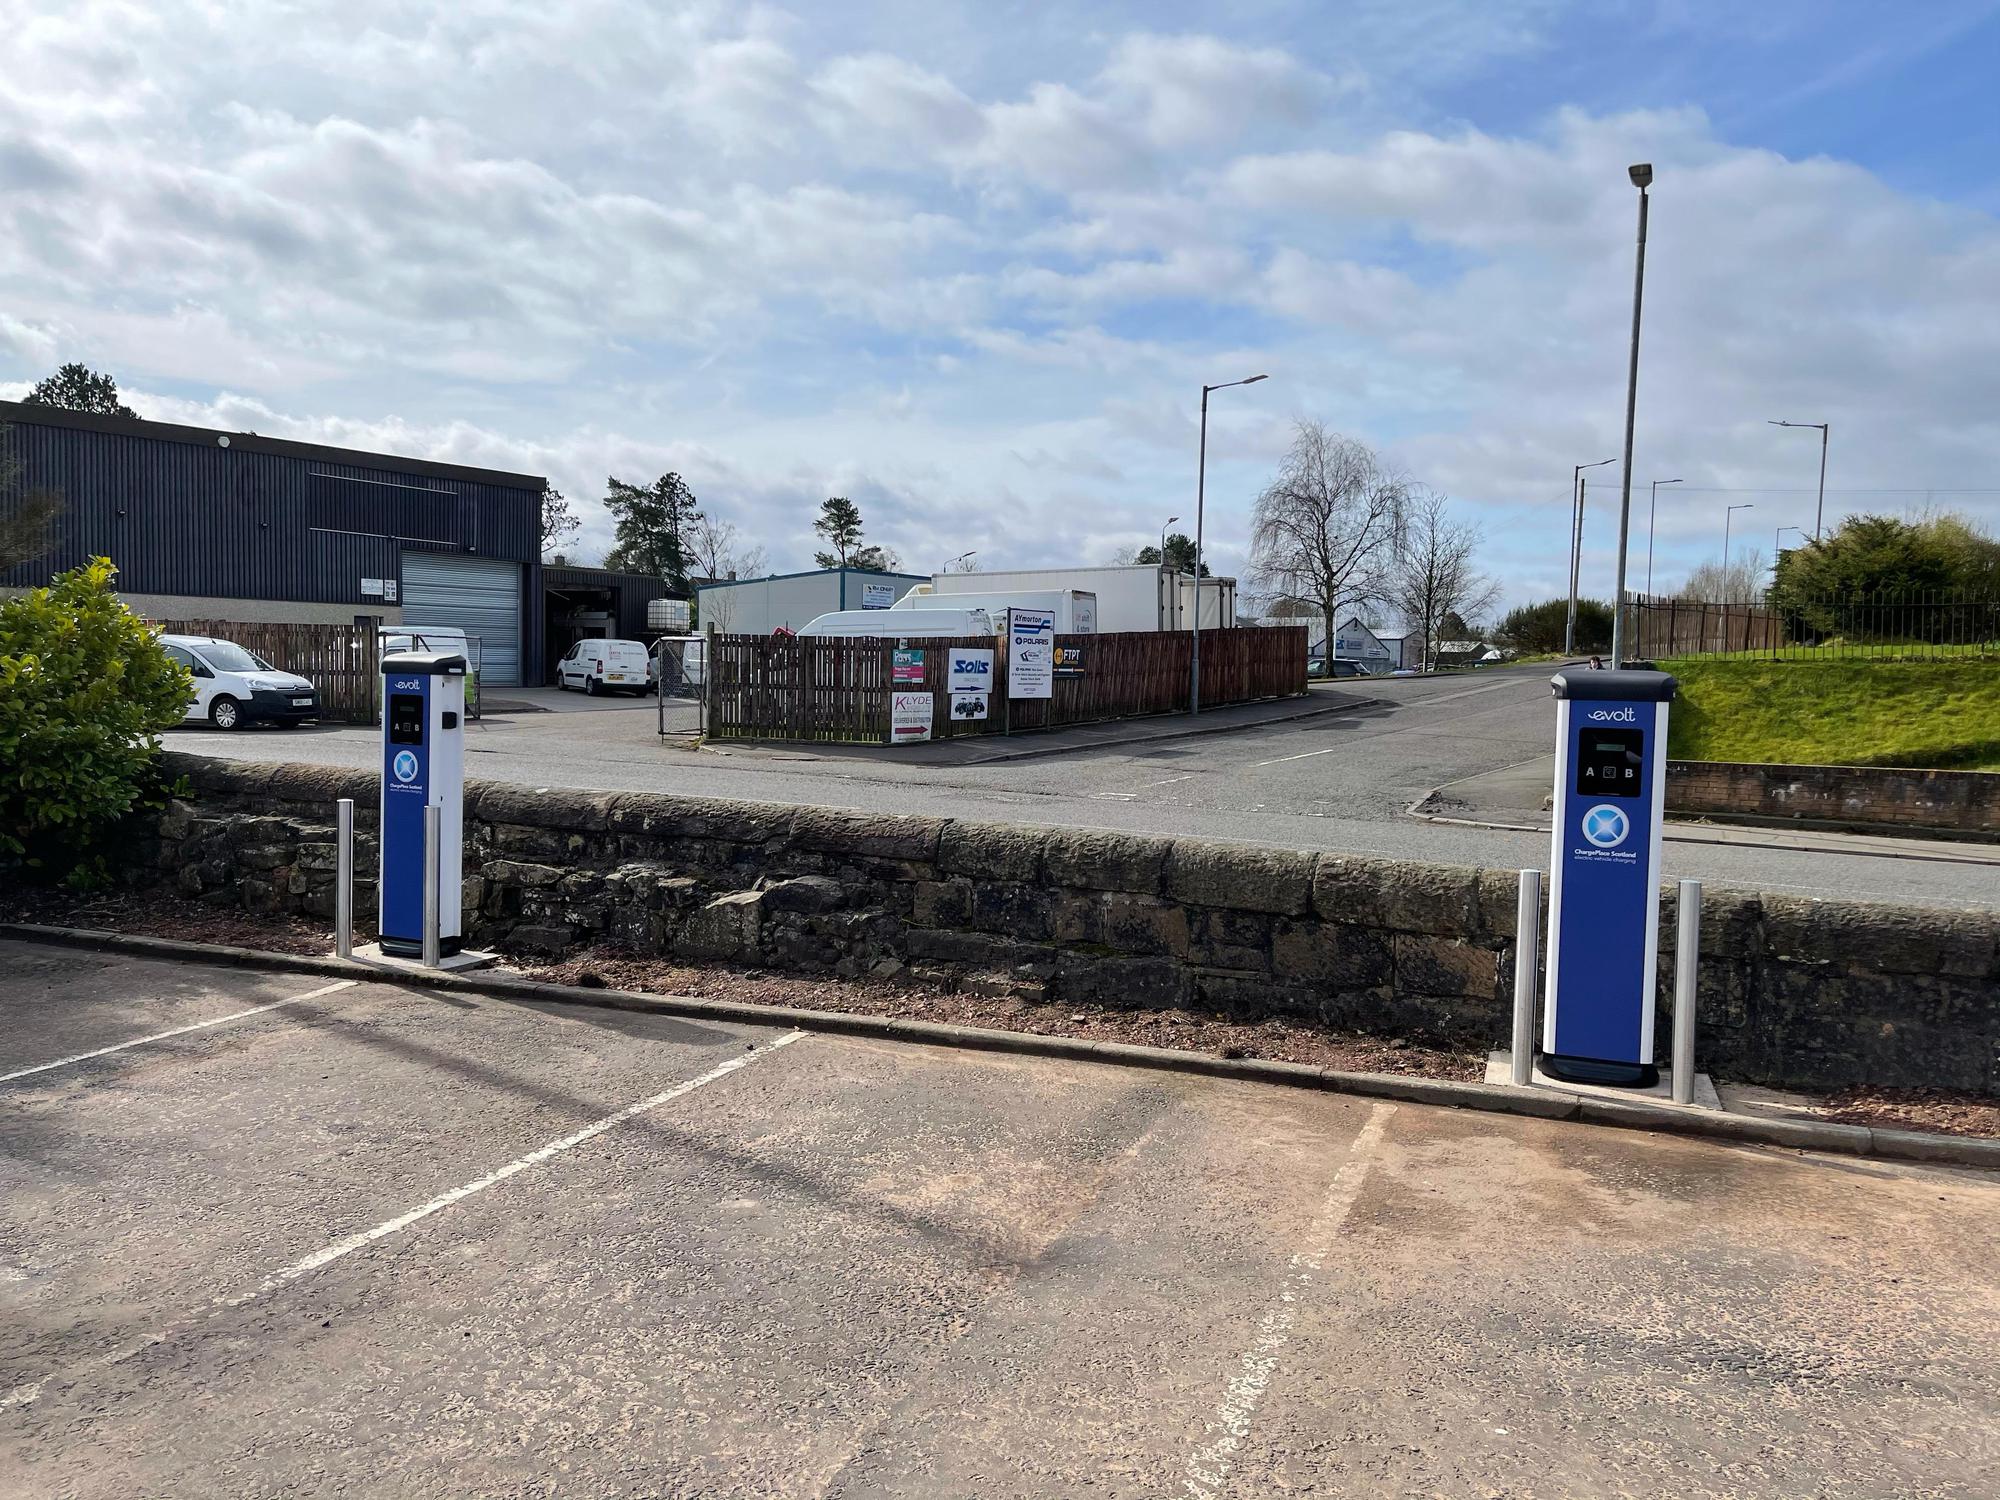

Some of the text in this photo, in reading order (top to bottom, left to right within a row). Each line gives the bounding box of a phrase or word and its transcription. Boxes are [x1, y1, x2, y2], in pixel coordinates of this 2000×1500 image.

[1063, 649, 1080, 661] FTPT
[394, 679, 420, 690] evolt
[895, 696, 931, 710] KLYDE
[1587, 707, 1636, 722] evolt
[1585, 767, 1634, 778] A B
[1574, 848, 1610, 856] ChargePlace
